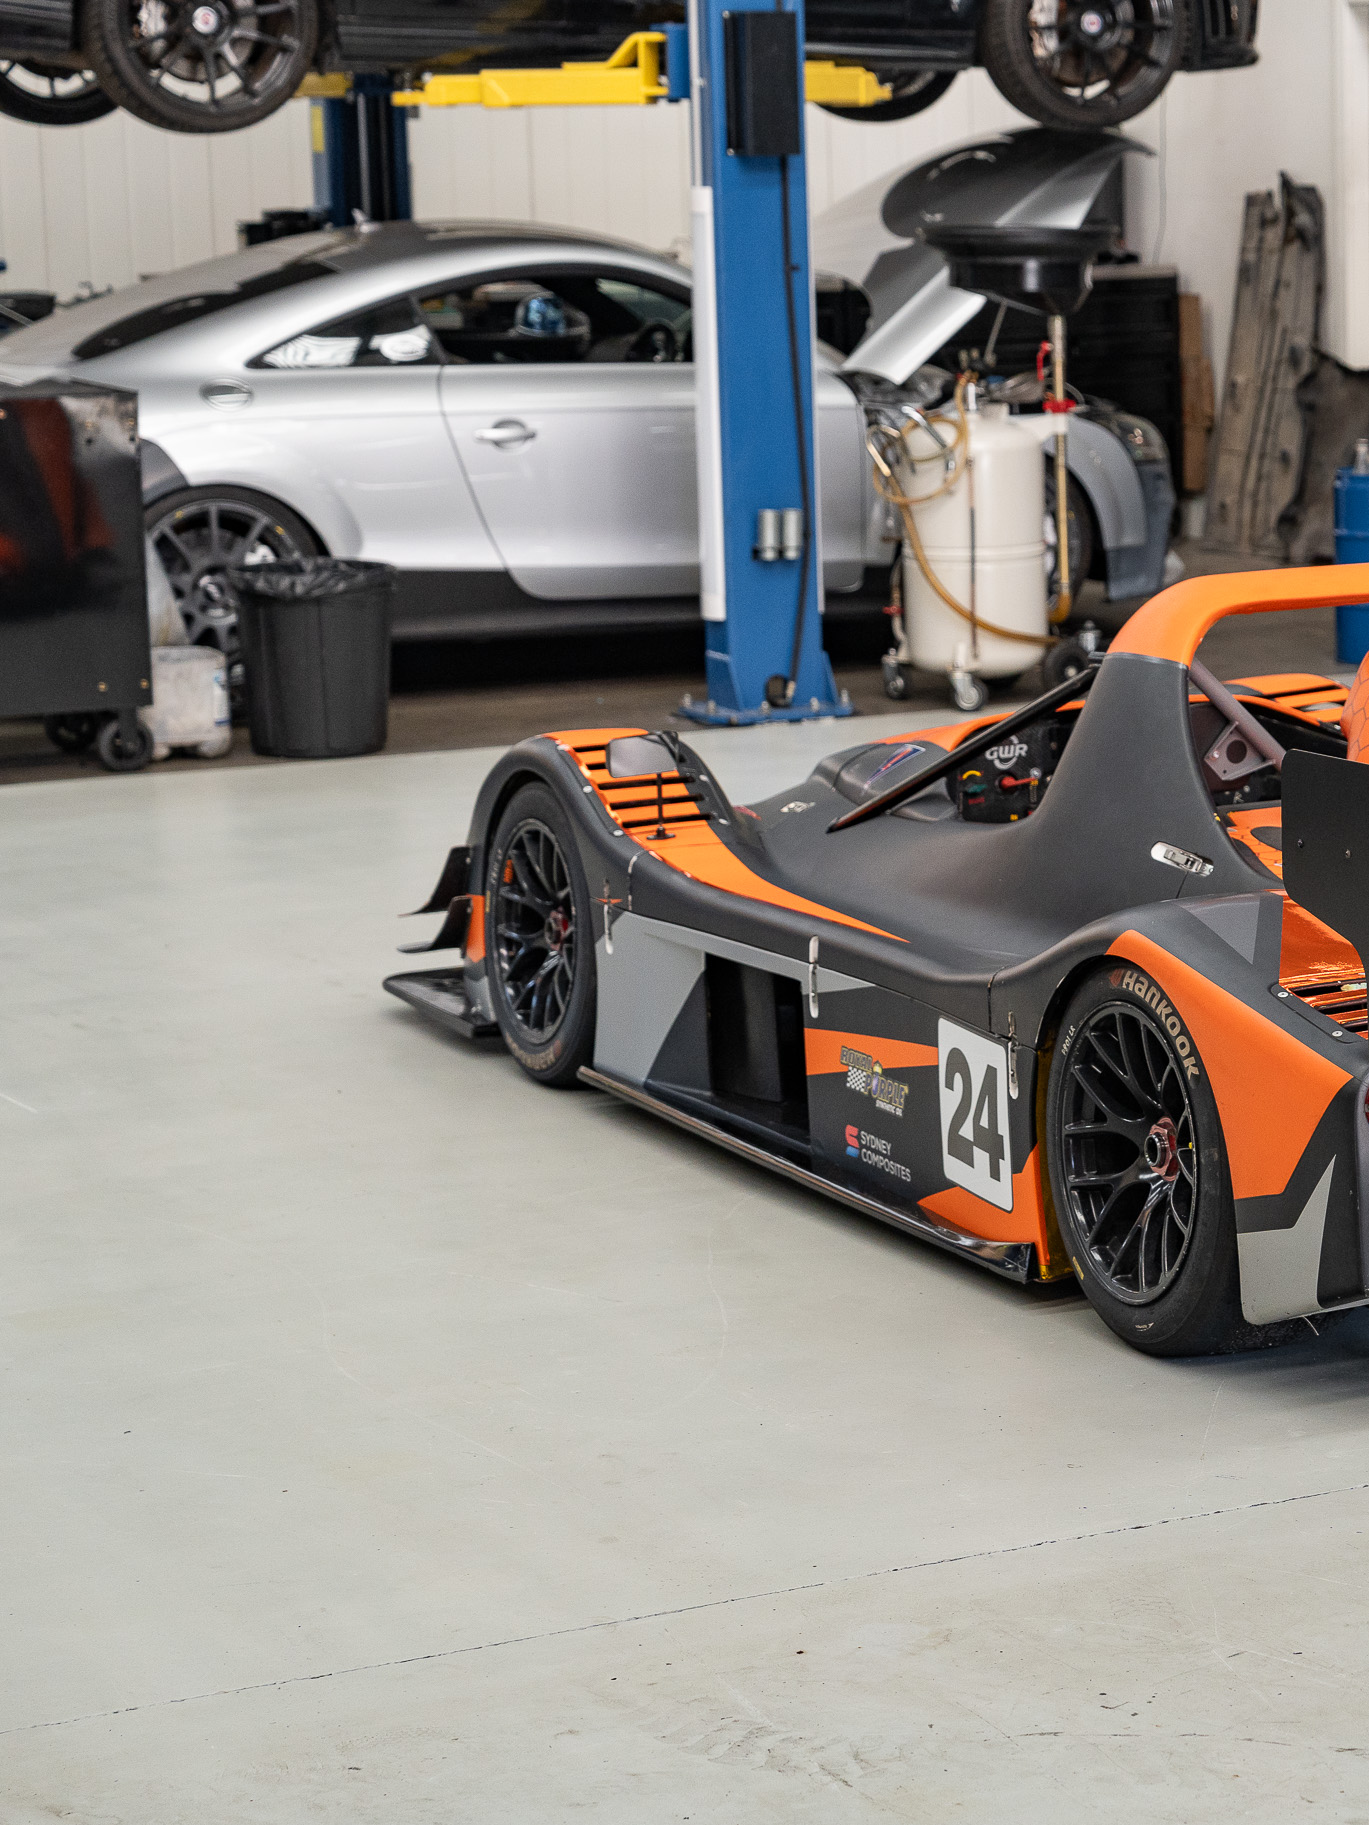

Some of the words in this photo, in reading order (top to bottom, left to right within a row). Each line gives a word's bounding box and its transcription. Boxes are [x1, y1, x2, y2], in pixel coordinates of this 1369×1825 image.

[985, 743, 1028, 760] GWR
[840, 1046, 872, 1072] ROYAL
[863, 1070, 908, 1109] PURPLE
[945, 1047, 1005, 1183] 24
[860, 1131, 891, 1155] SYDNEY
[861, 1149, 911, 1182] COMPOSITES
